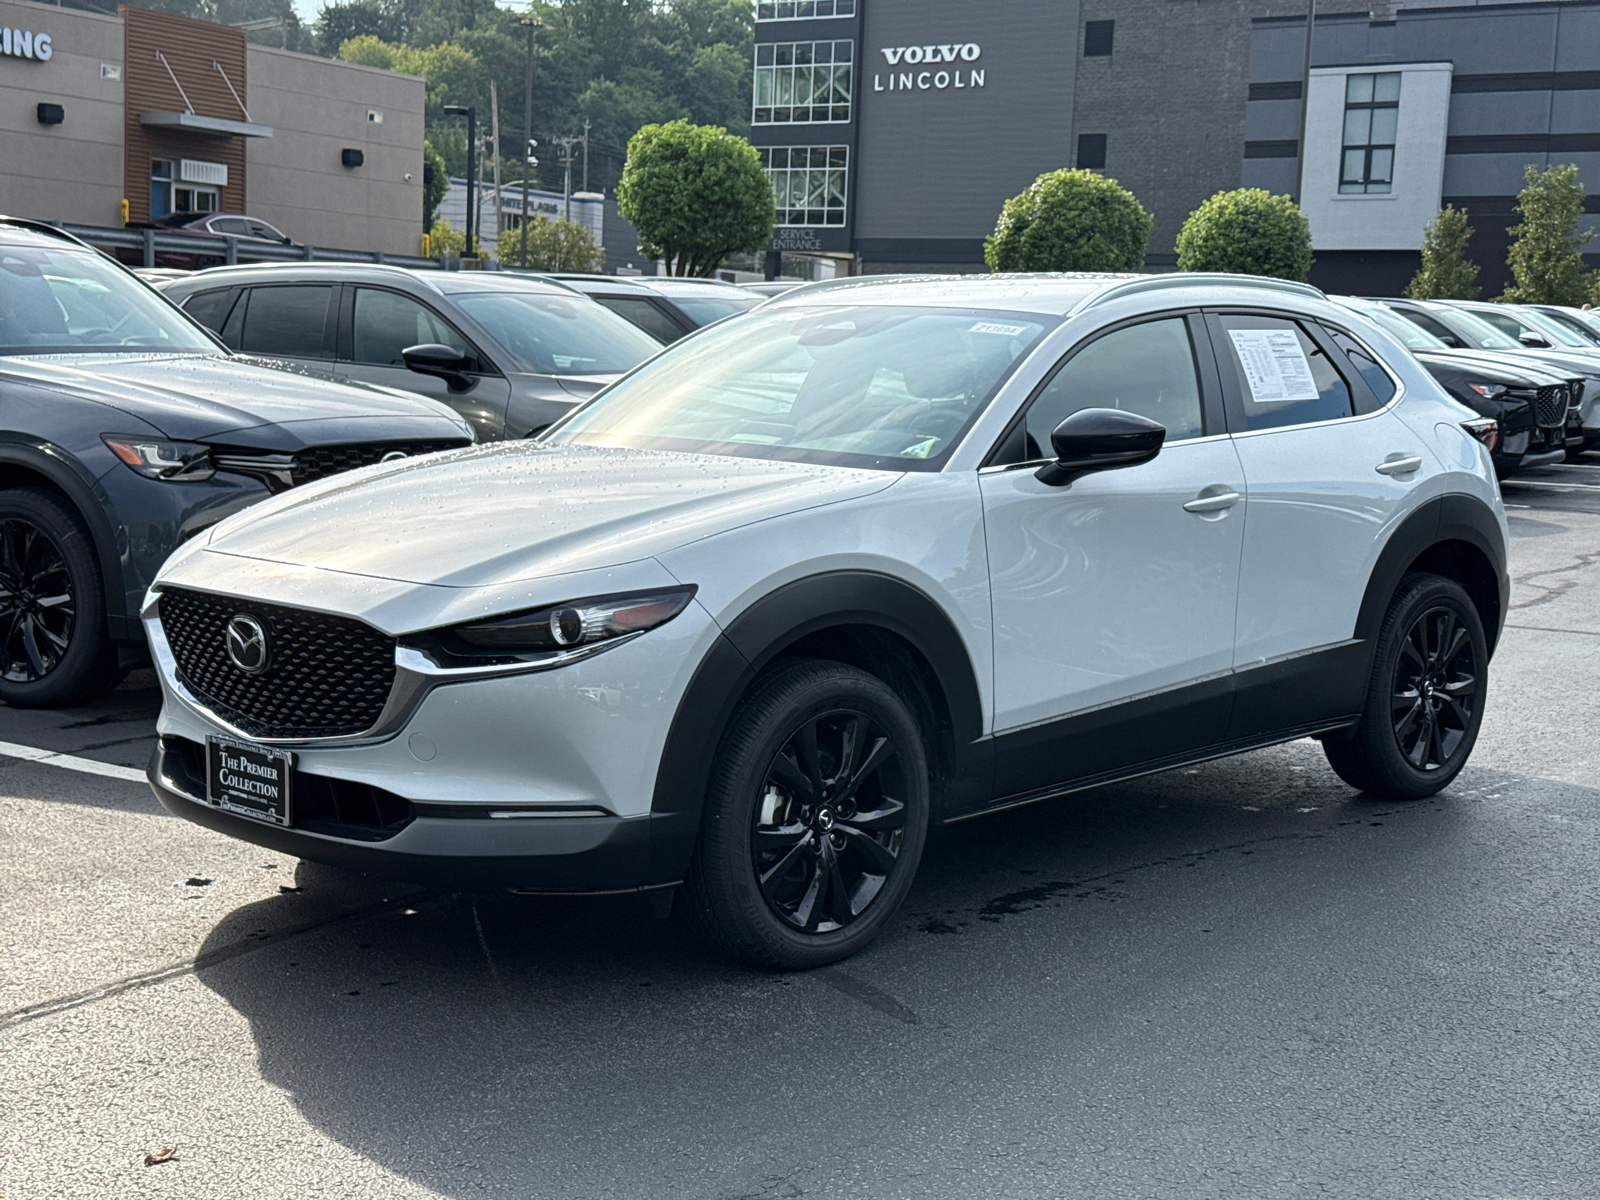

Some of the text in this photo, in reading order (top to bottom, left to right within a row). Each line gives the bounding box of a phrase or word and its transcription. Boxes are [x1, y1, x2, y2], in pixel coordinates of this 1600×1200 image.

[0, 26, 53, 61] ING
[881, 43, 981, 65] VOLVO
[874, 69, 985, 91] LINCOLN
[773, 240, 822, 250] ENTRANCE
[780, 229, 815, 239] SERVICE
[219, 751, 279, 780] THE PREMIER
[219, 768, 279, 799] COLLECTION
